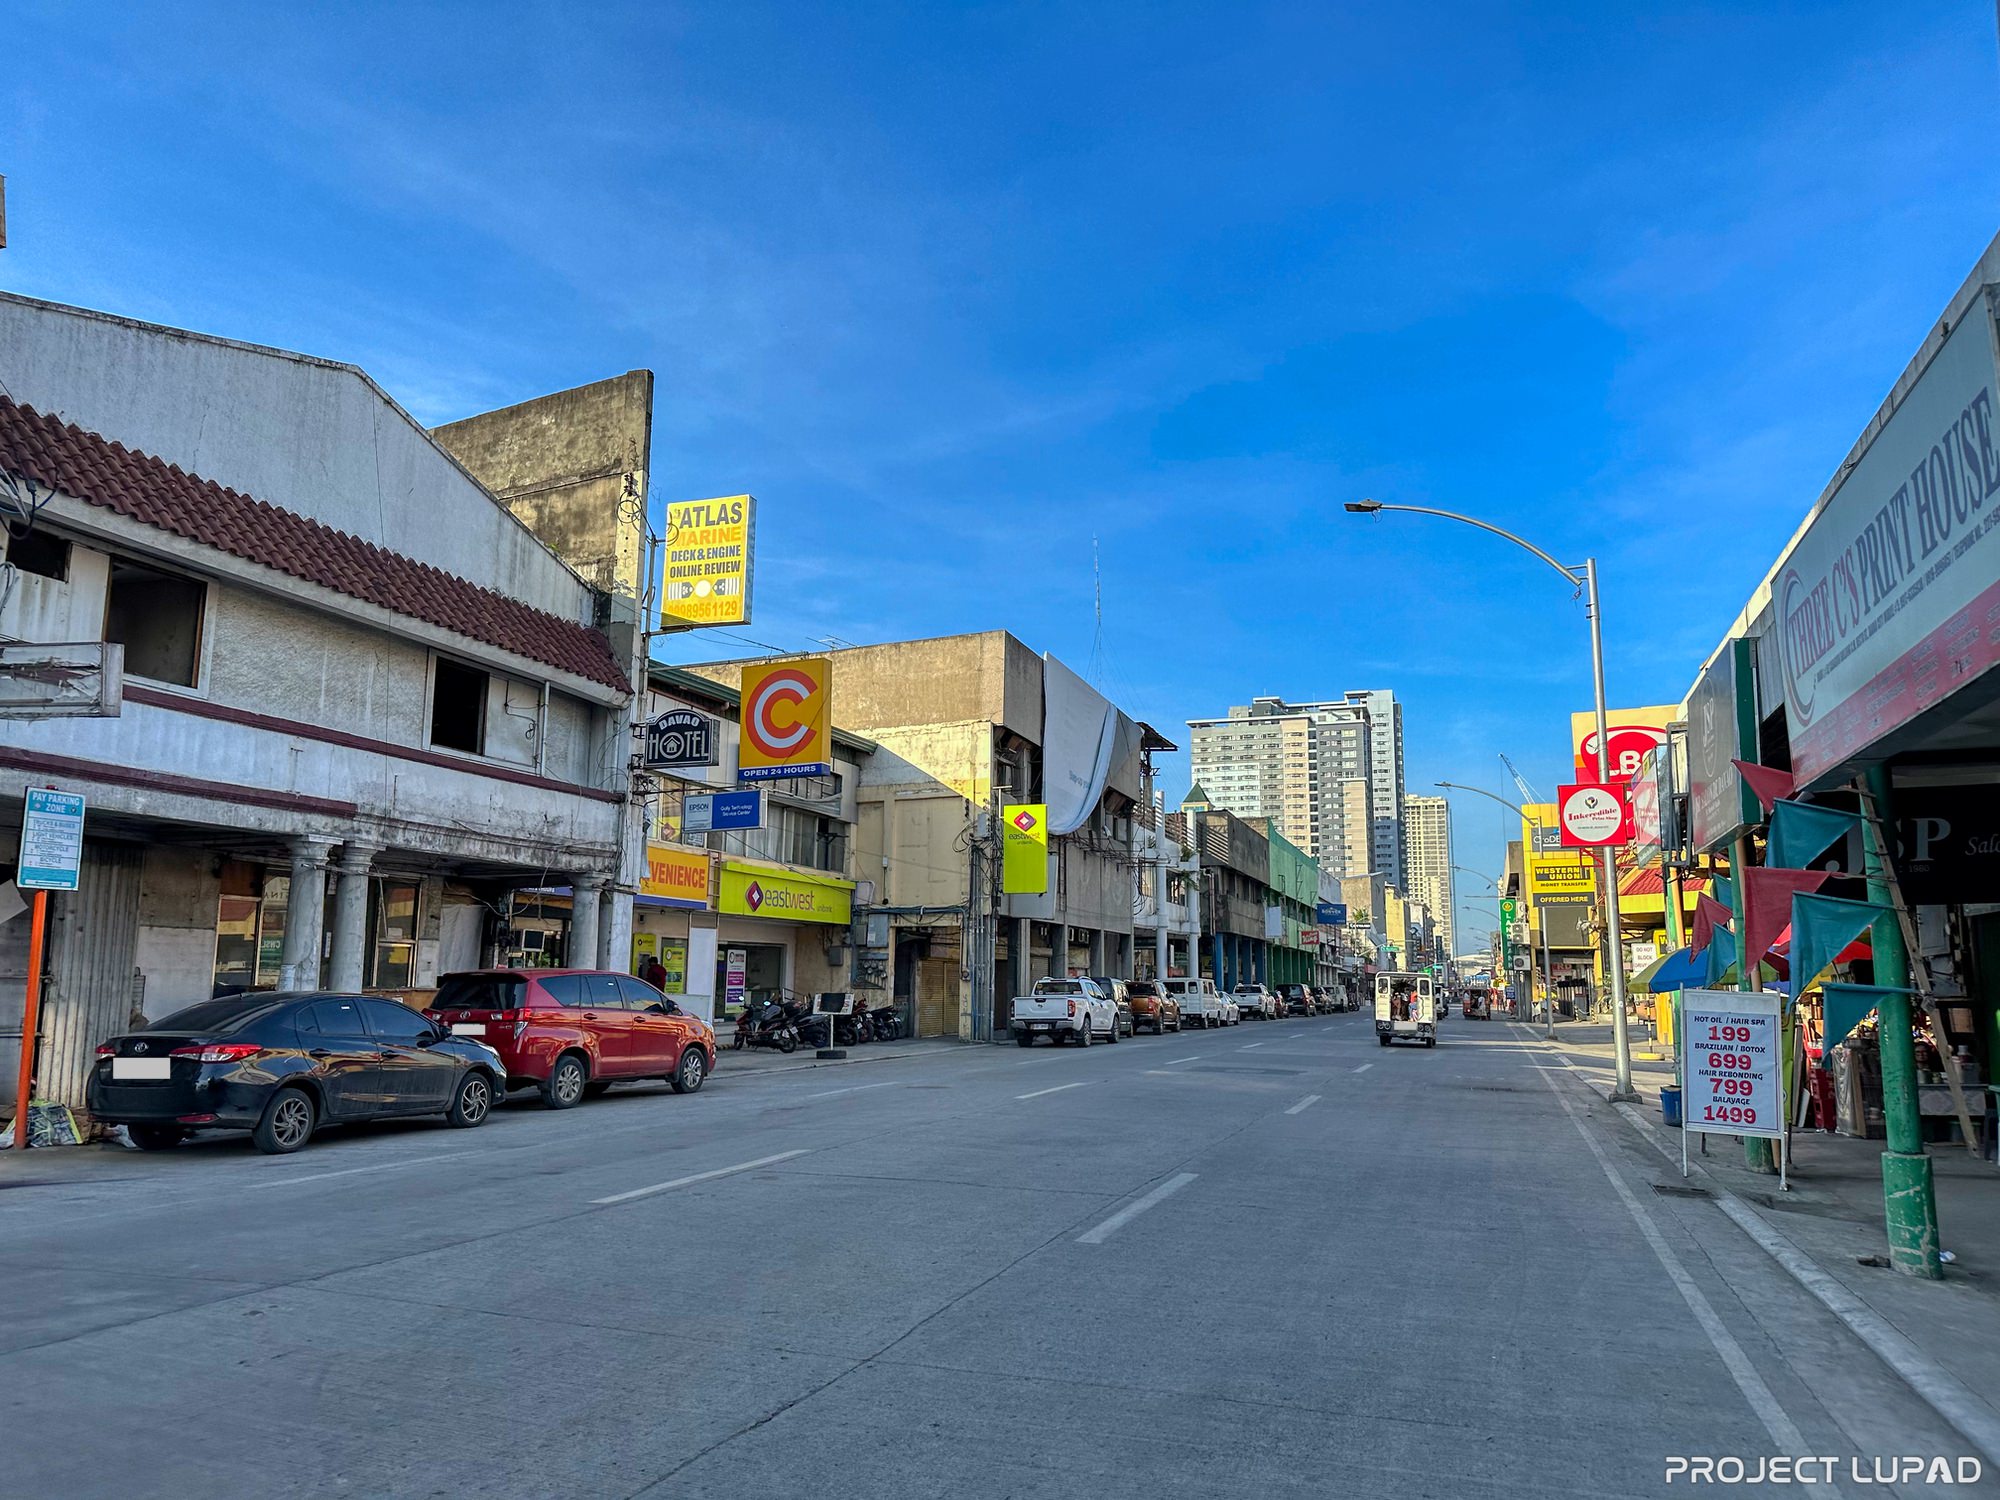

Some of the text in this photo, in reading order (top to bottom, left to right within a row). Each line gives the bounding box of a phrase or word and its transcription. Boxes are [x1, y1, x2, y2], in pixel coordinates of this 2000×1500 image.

[680, 502, 742, 529] ATLAS
[1788, 576, 1835, 680] THREE
[1855, 481, 1915, 616] PRINT
[1910, 386, 2000, 561] HOUSE
[671, 549, 696, 562] DECK
[706, 545, 741, 560] ENGINE
[670, 560, 740, 578] ONLINE REVIEW
[659, 714, 700, 730] DAVAO
[743, 765, 816, 777] OPEN 24 HOURS
[32, 791, 80, 805] PAY PARKING
[46, 803, 66, 813] ZONE
[689, 803, 709, 811] EPSON
[649, 861, 705, 888] VENIENCE
[764, 887, 815, 911] eastwest
[1751, 1018, 1766, 1026] SPA
[1708, 1025, 1751, 1042] 199
[1694, 1043, 1734, 1051] BRAZILIAN
[1708, 1053, 1752, 1070] 699
[1698, 1069, 1763, 1080] HAIR REBONDING
[1710, 1078, 1753, 1096] 799
[1712, 1096, 1751, 1104] BALAYAGE
[1704, 1105, 1756, 1124] 1499
